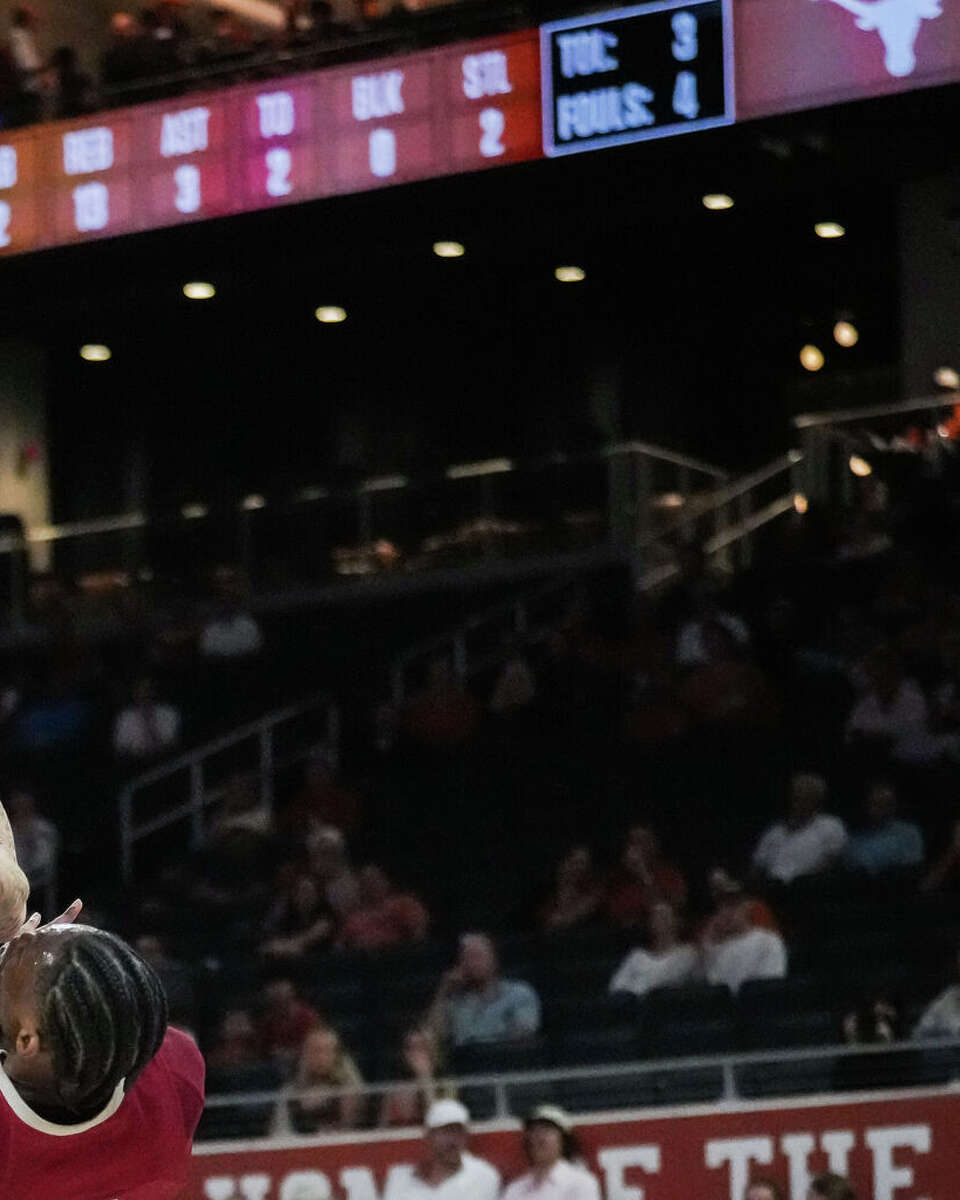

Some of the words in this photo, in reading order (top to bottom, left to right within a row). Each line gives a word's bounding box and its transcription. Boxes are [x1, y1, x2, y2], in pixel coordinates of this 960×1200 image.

[671, 11, 698, 62] 3
[672, 70, 700, 119] 4
[265, 148, 293, 197] 2
[478, 108, 505, 158] 2
